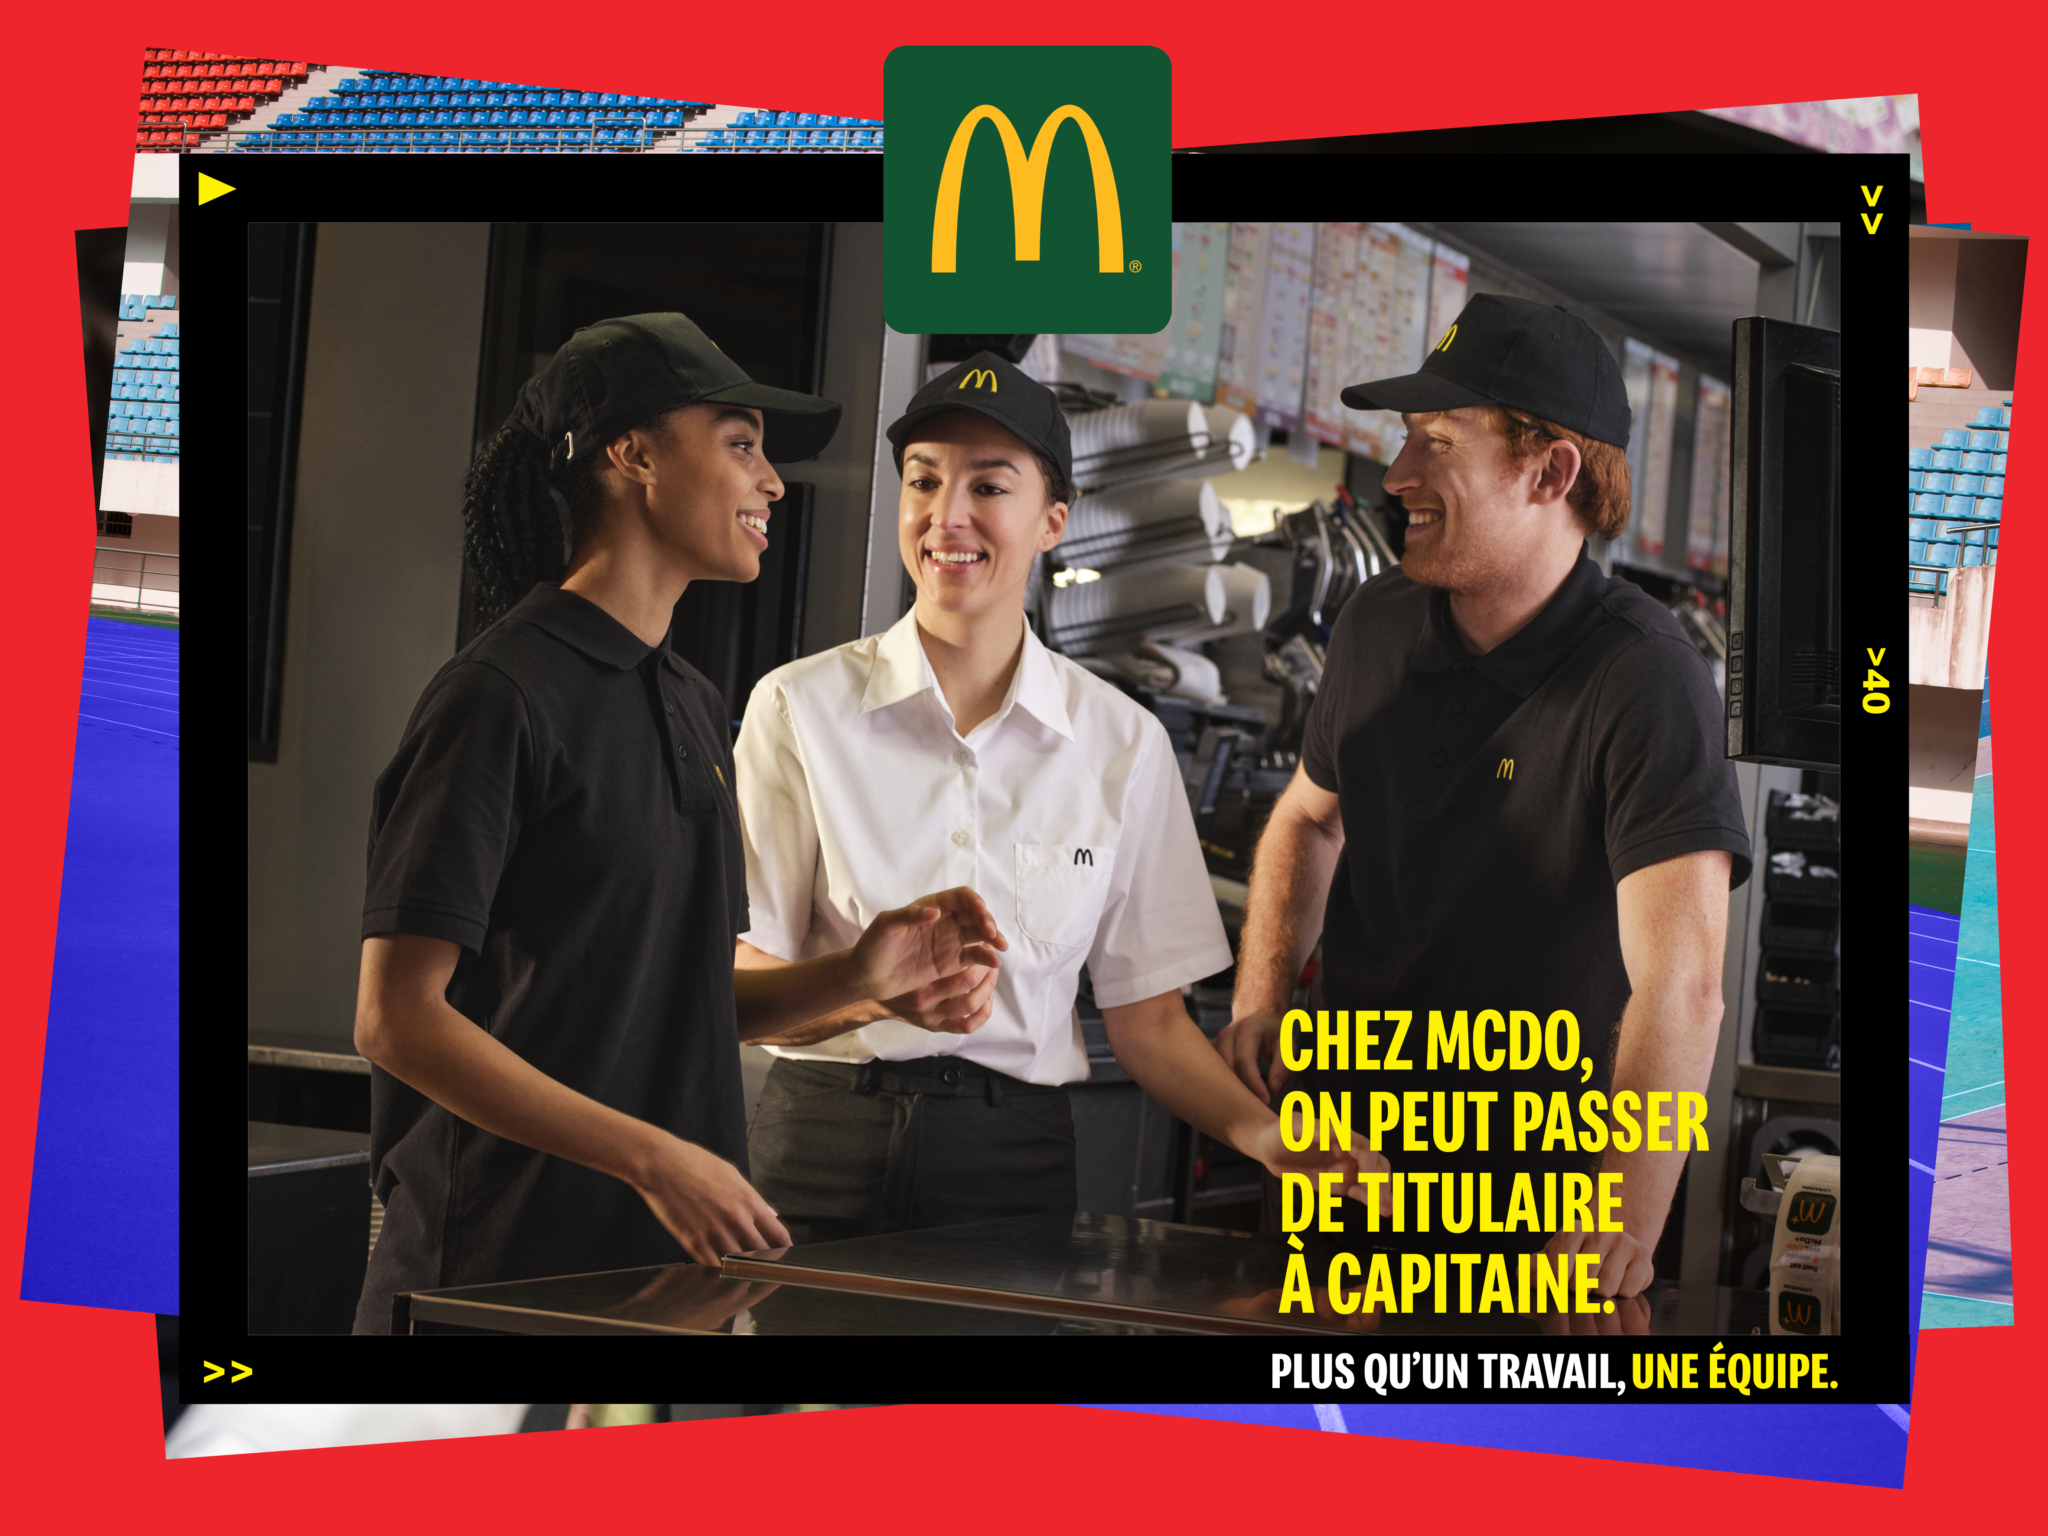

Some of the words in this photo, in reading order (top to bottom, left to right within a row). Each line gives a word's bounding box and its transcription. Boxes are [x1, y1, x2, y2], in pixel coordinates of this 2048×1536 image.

[1801, 1185, 1832, 1193] LIVRAISON
[1795, 1236, 1822, 1246] McDo+
[1786, 1252, 1811, 1262] simple
[1803, 1263, 1818, 1273] Tout
[1783, 1284, 1813, 1293] LIVRAISON
